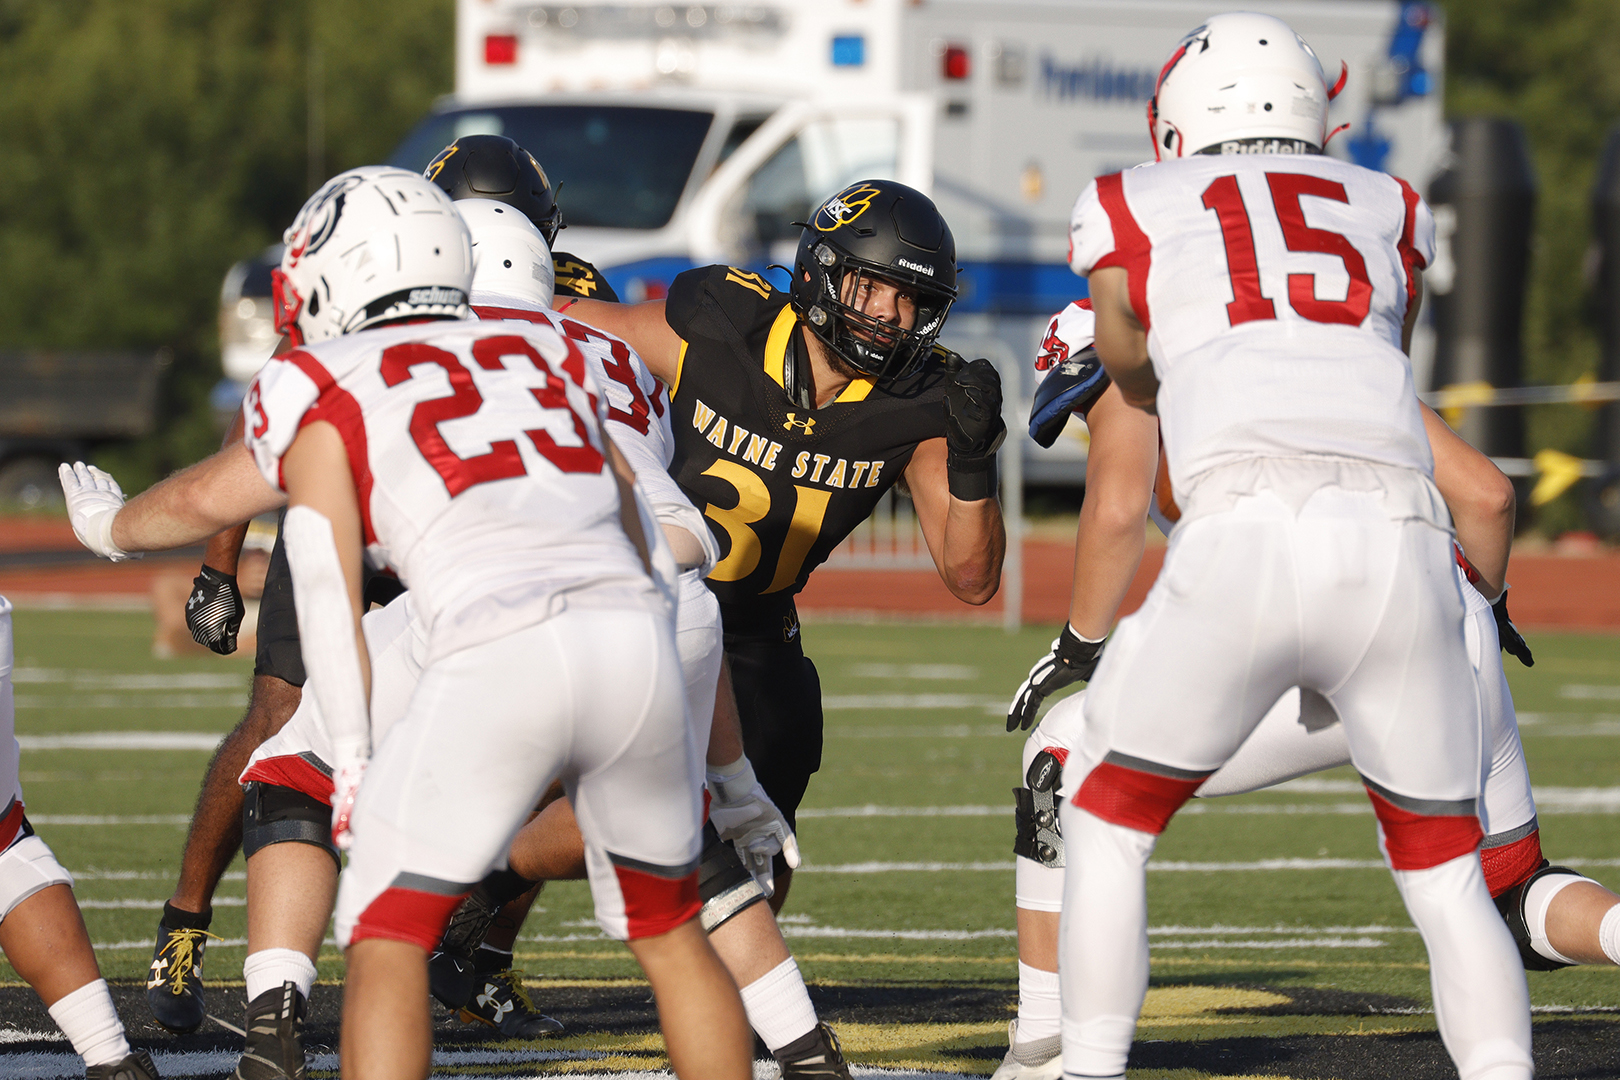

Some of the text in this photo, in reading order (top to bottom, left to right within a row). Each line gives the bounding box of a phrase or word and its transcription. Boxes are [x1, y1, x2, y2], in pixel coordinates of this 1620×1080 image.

[1221, 140, 1307, 155] Riddell
[826, 197, 853, 221] WSC
[1201, 172, 1373, 328] 15
[898, 258, 935, 277] Riddell
[380, 335, 606, 499] 23
[692, 398, 783, 471] WAYNE
[791, 450, 884, 489] STATE
[700, 458, 833, 595] 31
